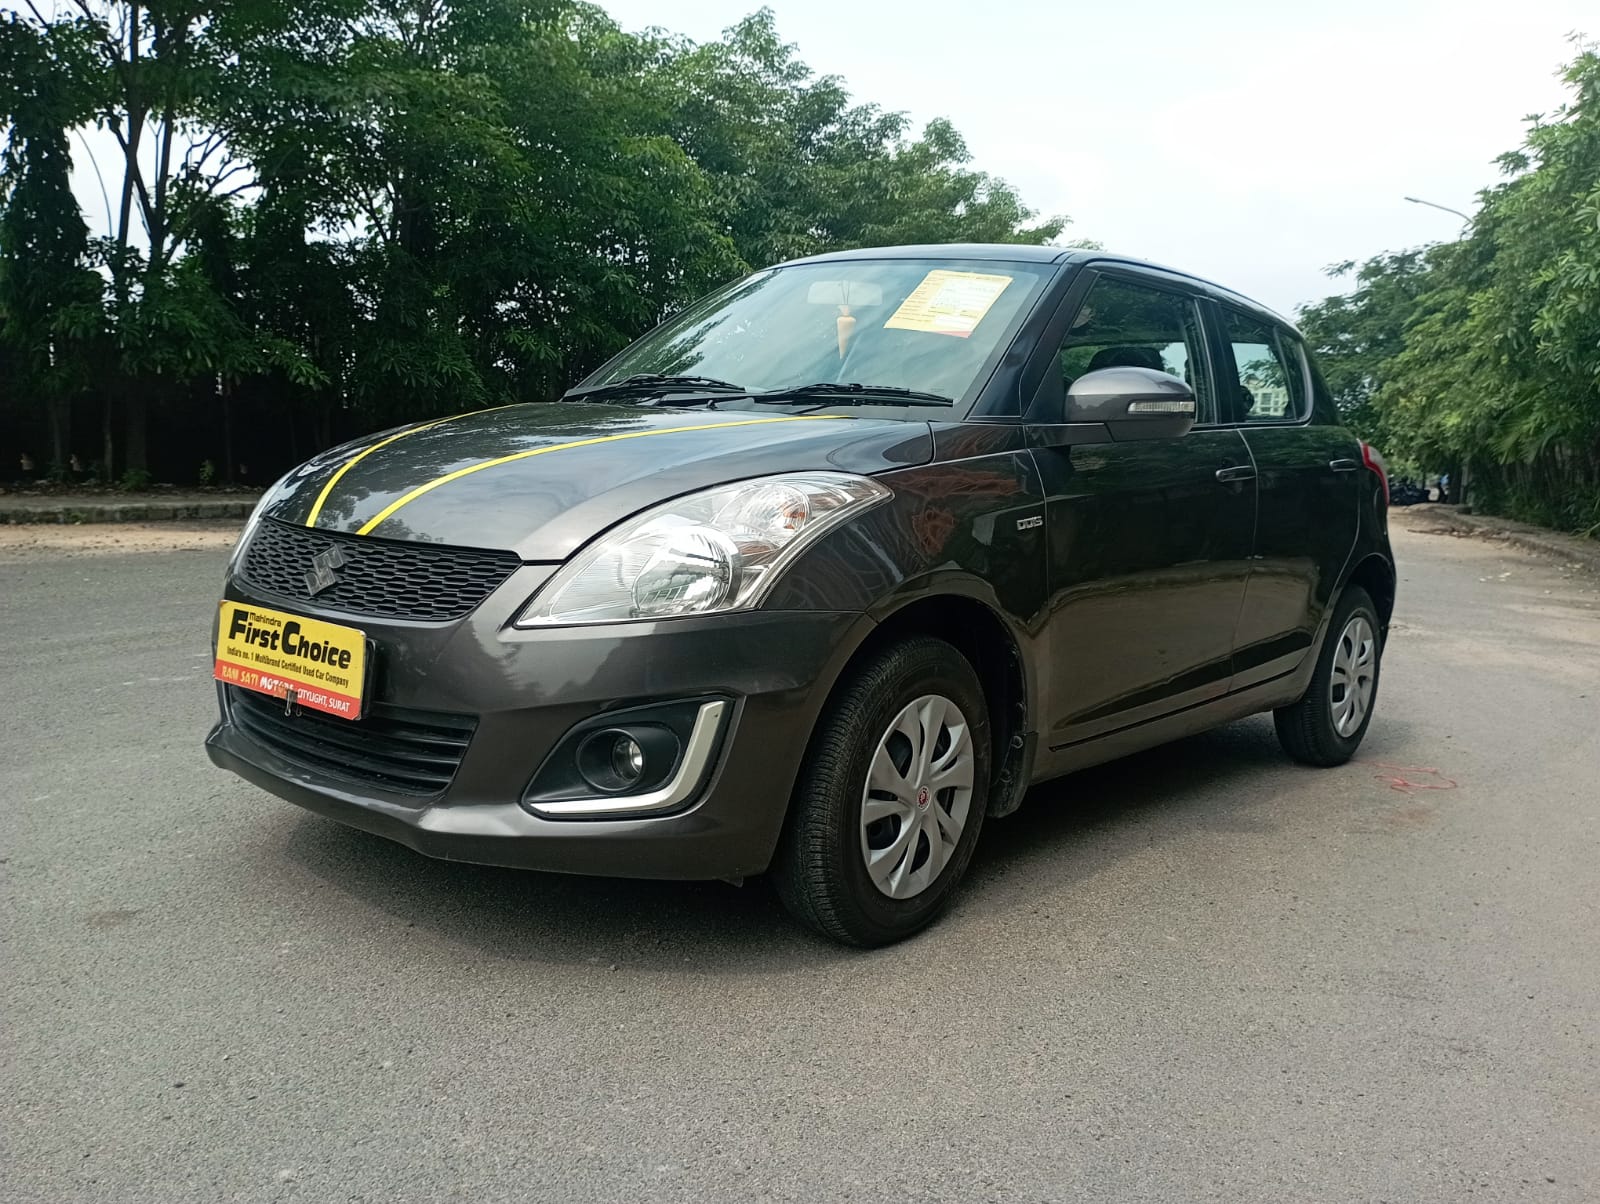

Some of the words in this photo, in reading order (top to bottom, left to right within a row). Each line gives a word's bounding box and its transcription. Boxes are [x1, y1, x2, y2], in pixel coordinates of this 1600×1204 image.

[228, 608, 280, 651] First
[281, 620, 352, 670] Choice
[249, 612, 282, 627] Mahindra
[227, 645, 242, 658] India's
[254, 653, 281, 668] Multibrand
[281, 659, 302, 674] Certified
[302, 665, 315, 678] Used
[315, 669, 325, 681] Car
[325, 671, 349, 688] Company
[240, 671, 259, 687] SATI
[328, 697, 351, 713] SURAT
